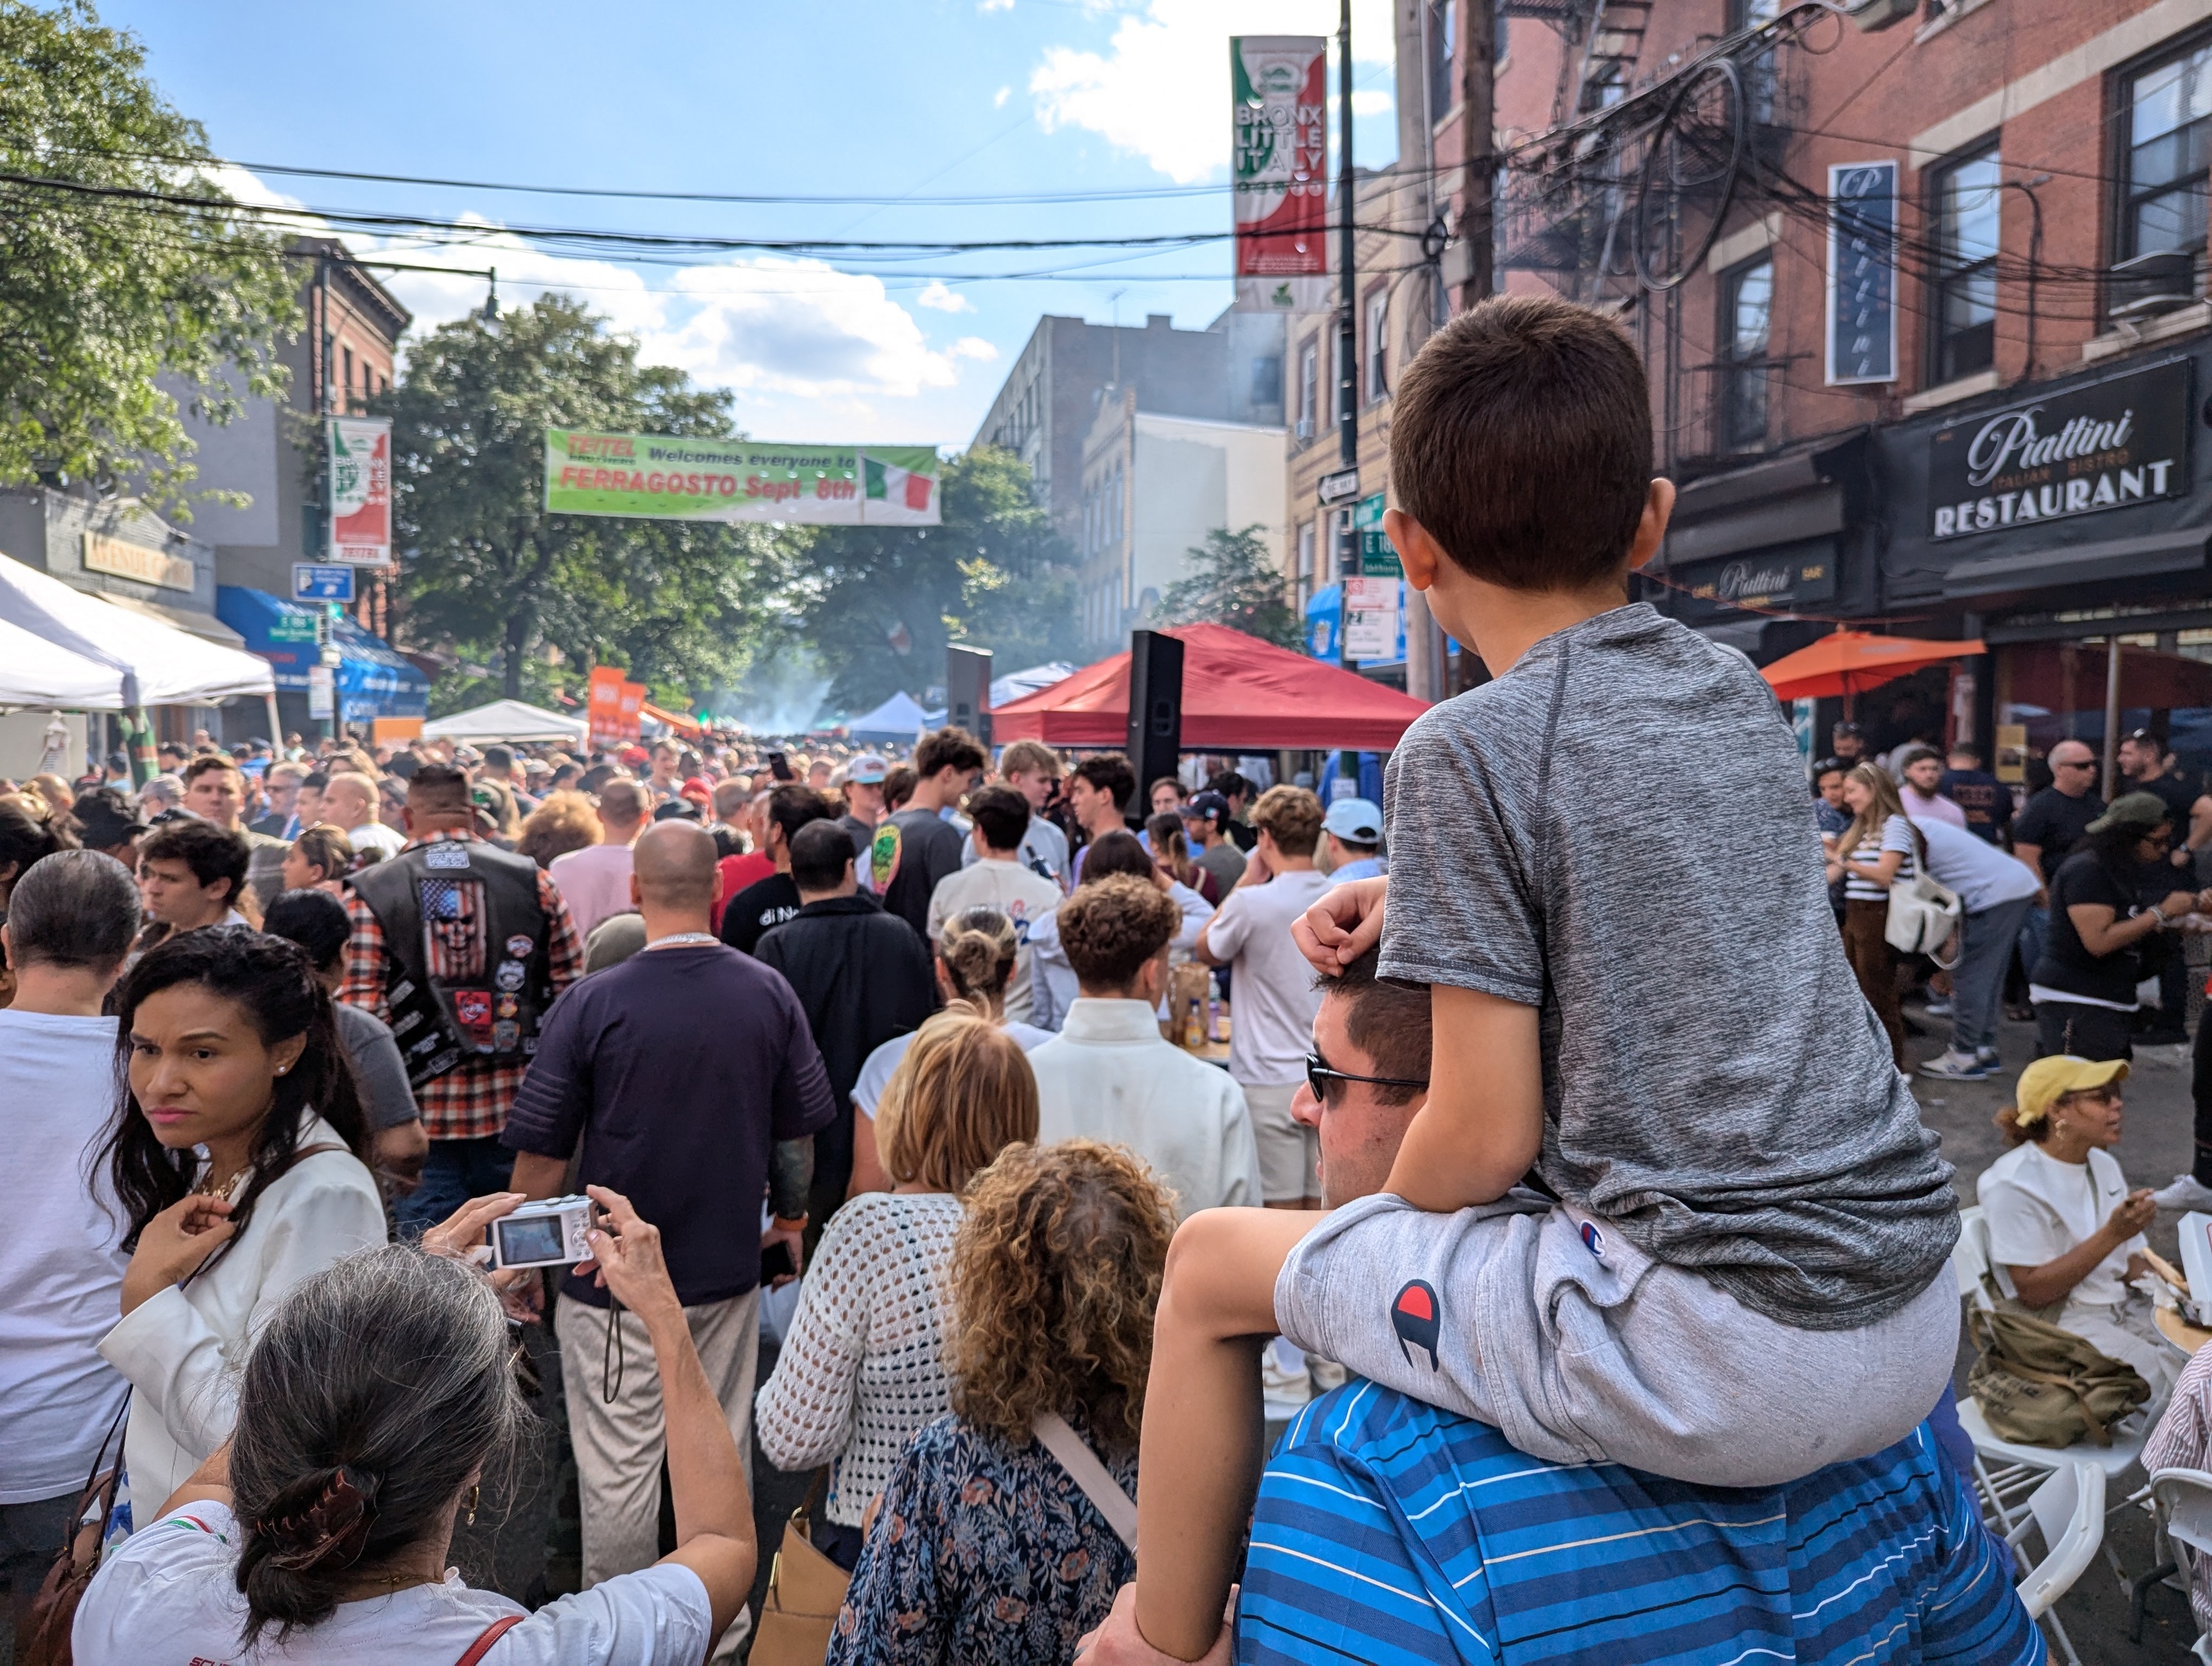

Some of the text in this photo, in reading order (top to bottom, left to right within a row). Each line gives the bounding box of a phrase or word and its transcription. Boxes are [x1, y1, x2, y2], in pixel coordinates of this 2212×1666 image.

[1237, 107, 1322, 126] BRONX
[1237, 127, 1322, 147] LITTLE
[1237, 149, 1323, 171] ITALY
[568, 436, 637, 457] TEITEL
[1967, 406, 2134, 487] Piattini
[649, 447, 856, 470] Welcomes everyone to
[560, 467, 856, 504] FERRAGOSTO Sept 8th
[1934, 458, 2174, 537] RESTAURANT
